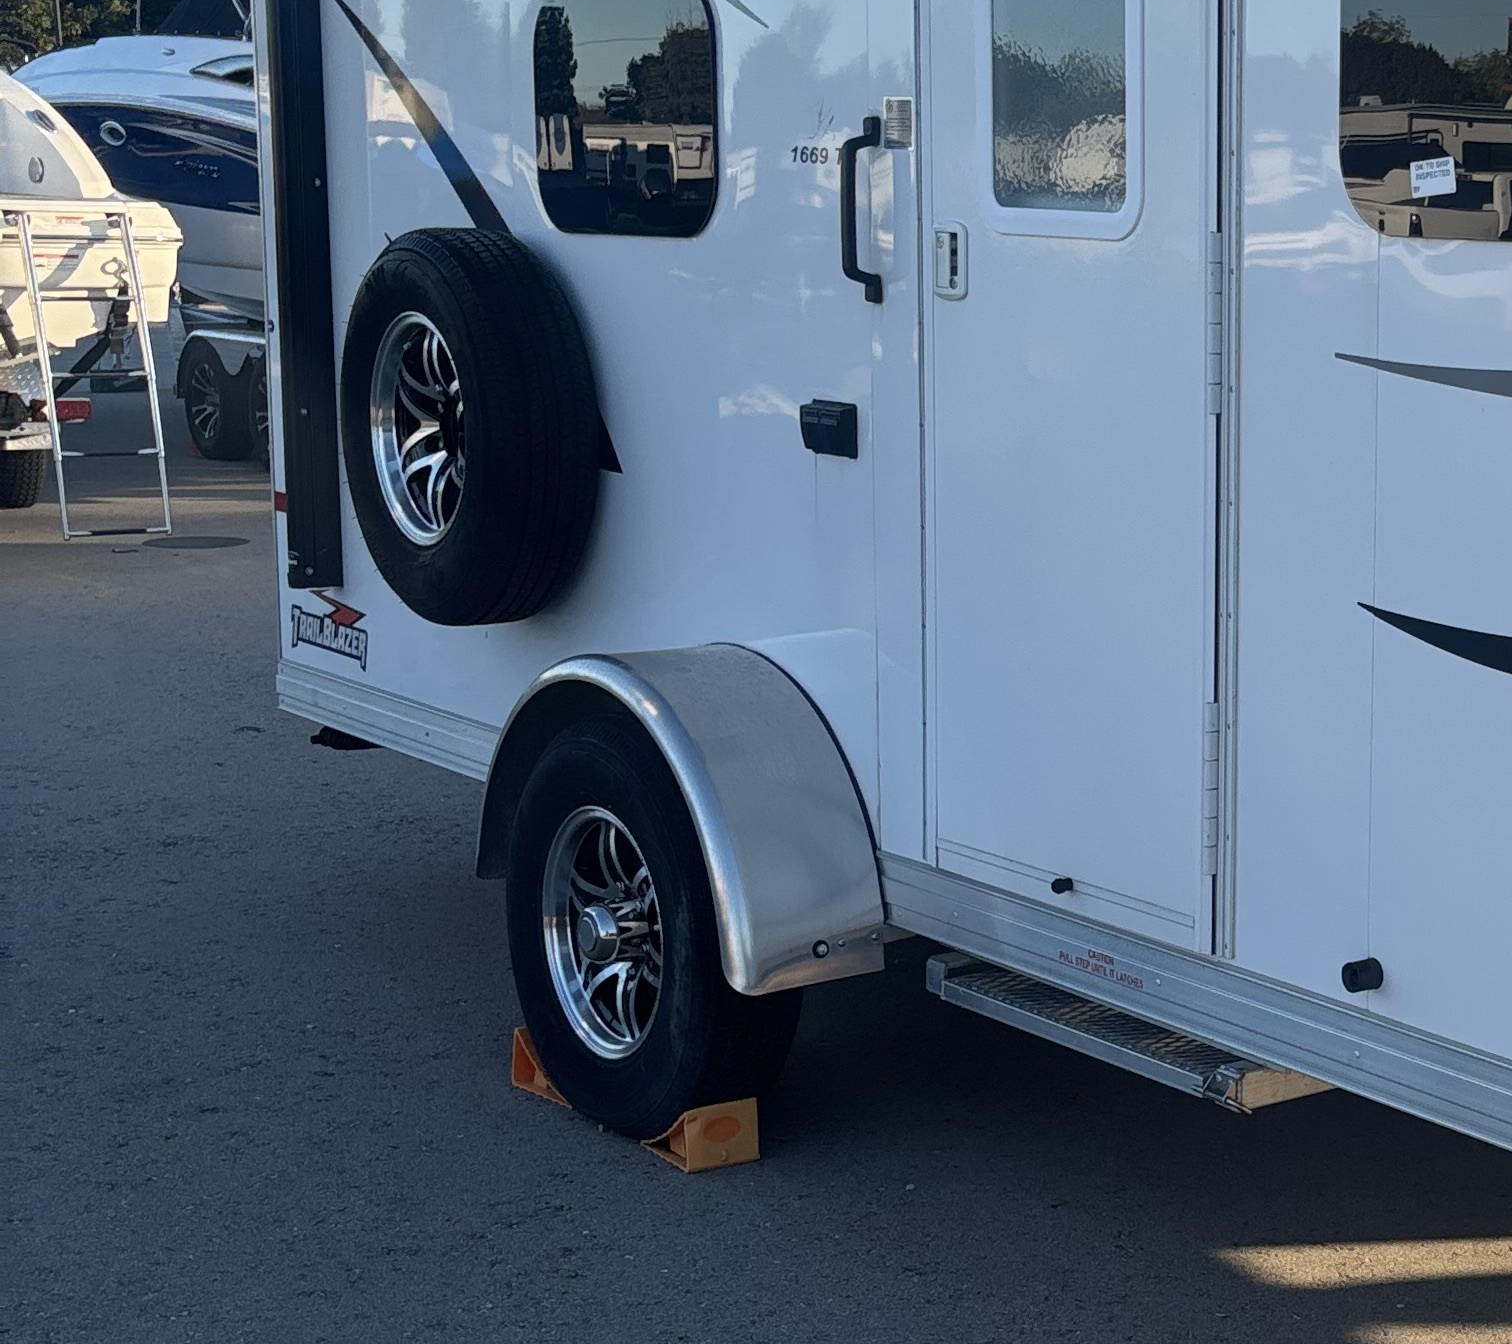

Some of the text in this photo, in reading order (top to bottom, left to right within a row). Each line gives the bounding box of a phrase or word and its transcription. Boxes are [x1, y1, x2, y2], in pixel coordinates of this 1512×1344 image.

[791, 146, 829, 164] 1669
[1088, 949, 1115, 966] CAUTION
[1075, 957, 1090, 969] STEP
[1116, 971, 1144, 989] LATCHES
